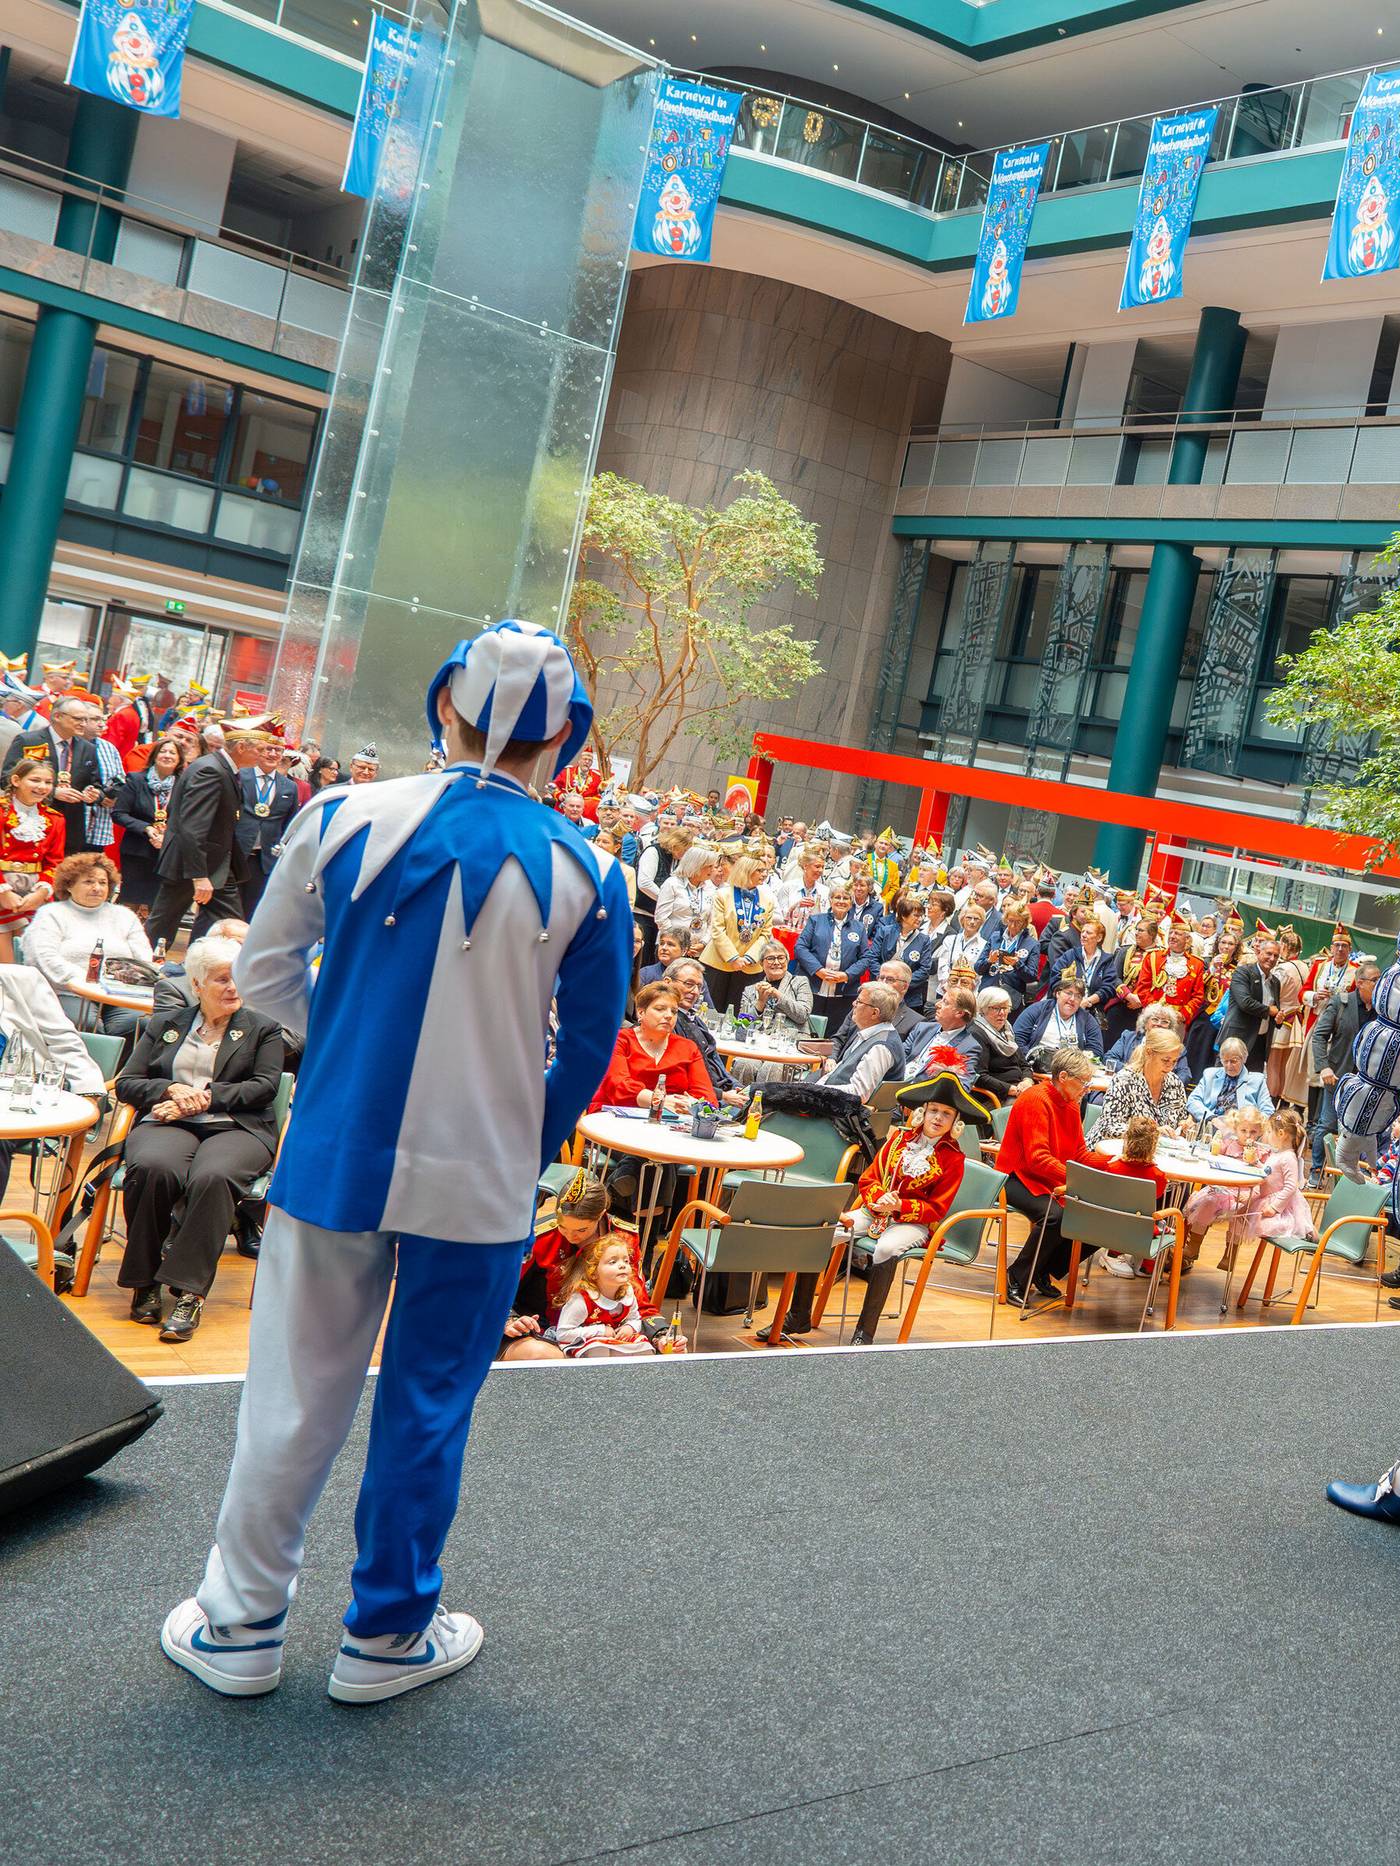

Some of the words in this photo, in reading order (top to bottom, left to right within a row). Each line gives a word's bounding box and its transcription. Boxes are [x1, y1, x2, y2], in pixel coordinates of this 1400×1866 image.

[666, 84, 715, 107] Karneval
[1161, 118, 1198, 137] Karneval
[1002, 152, 1033, 169] Karneval
